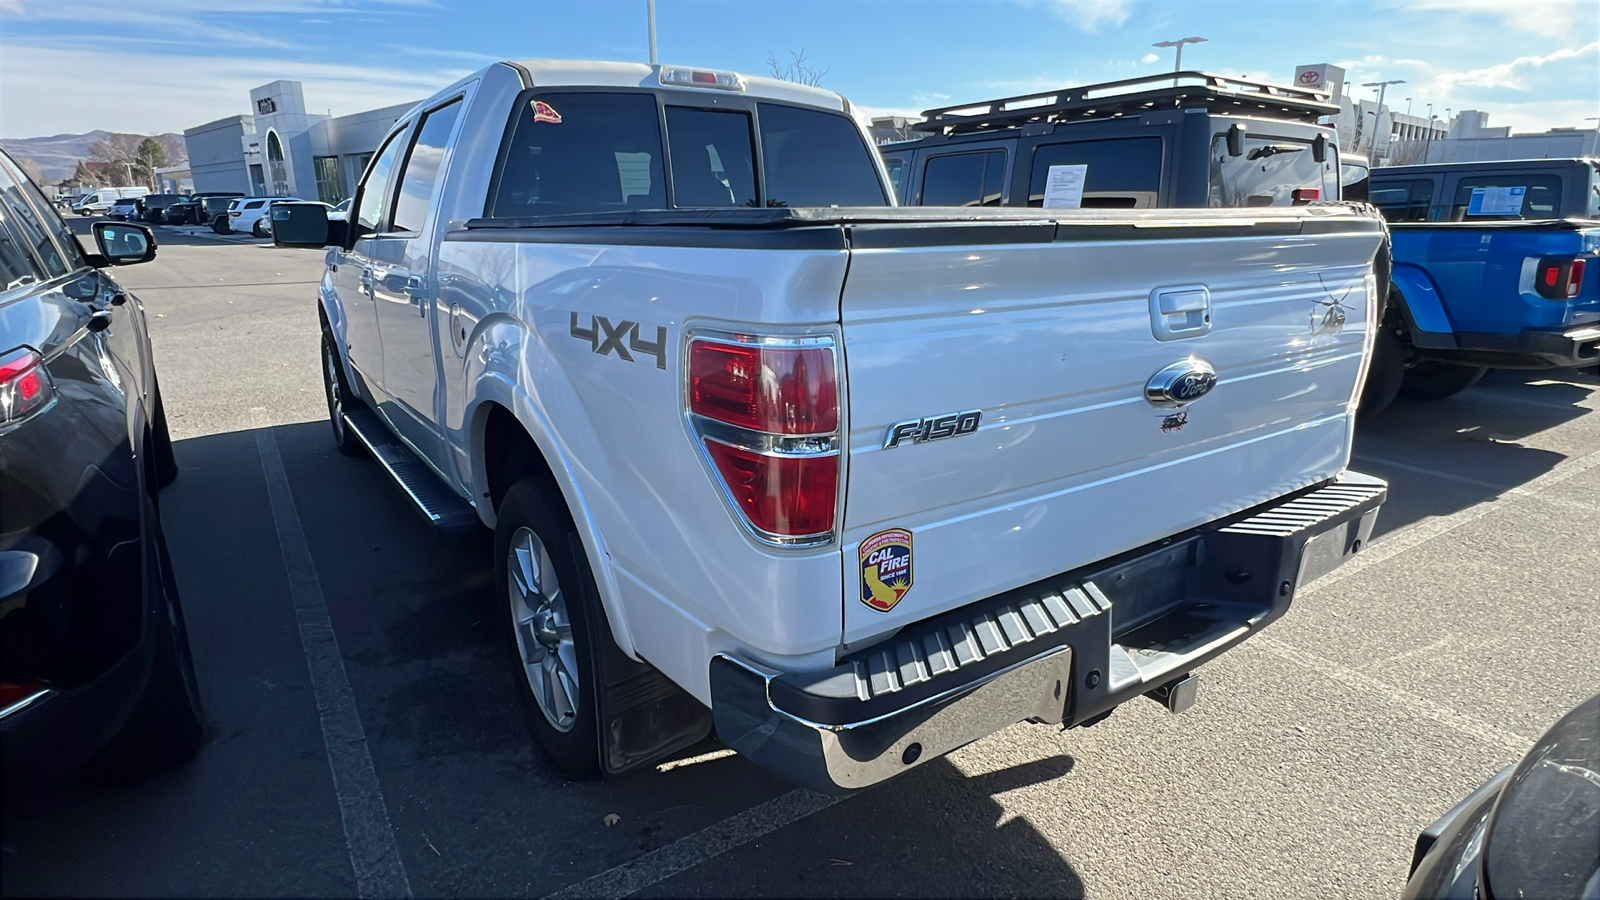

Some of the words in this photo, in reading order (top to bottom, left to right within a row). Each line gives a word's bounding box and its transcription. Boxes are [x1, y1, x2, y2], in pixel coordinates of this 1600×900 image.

[570, 311, 667, 370] 4X4
[1180, 374, 1210, 397] Ford
[882, 409, 983, 450] F-150
[869, 547, 894, 565] CAL
[880, 554, 910, 573] FIRE
[880, 572, 896, 581] SINCE
